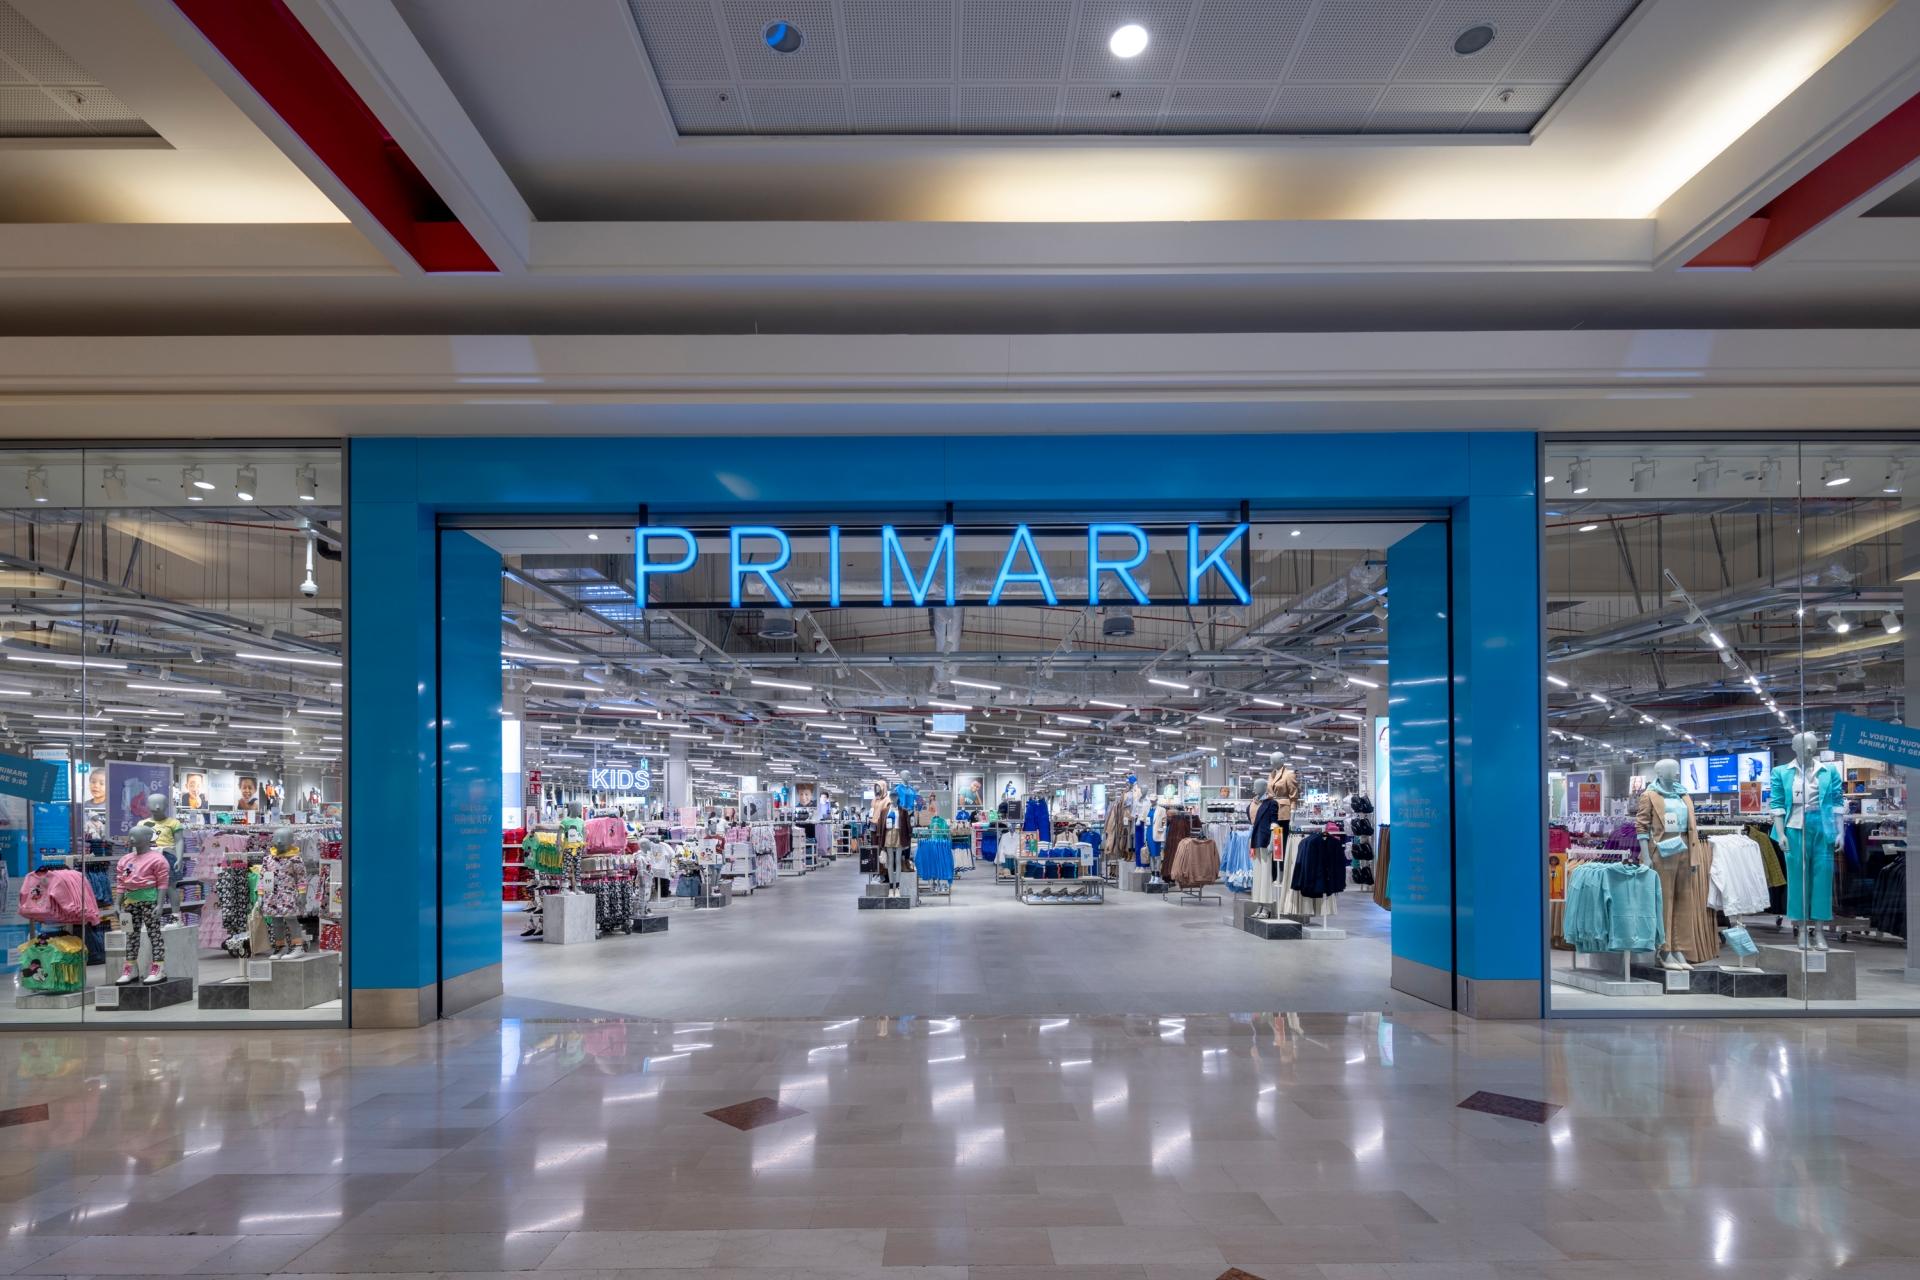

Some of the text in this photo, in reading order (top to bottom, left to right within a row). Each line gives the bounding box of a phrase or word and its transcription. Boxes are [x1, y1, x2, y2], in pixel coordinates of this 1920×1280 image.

[634, 523, 1252, 608] PRIMARK
[1860, 730, 1868, 738] IL
[1869, 732, 1899, 744] VOSTRO
[592, 769, 650, 790] KIDS
